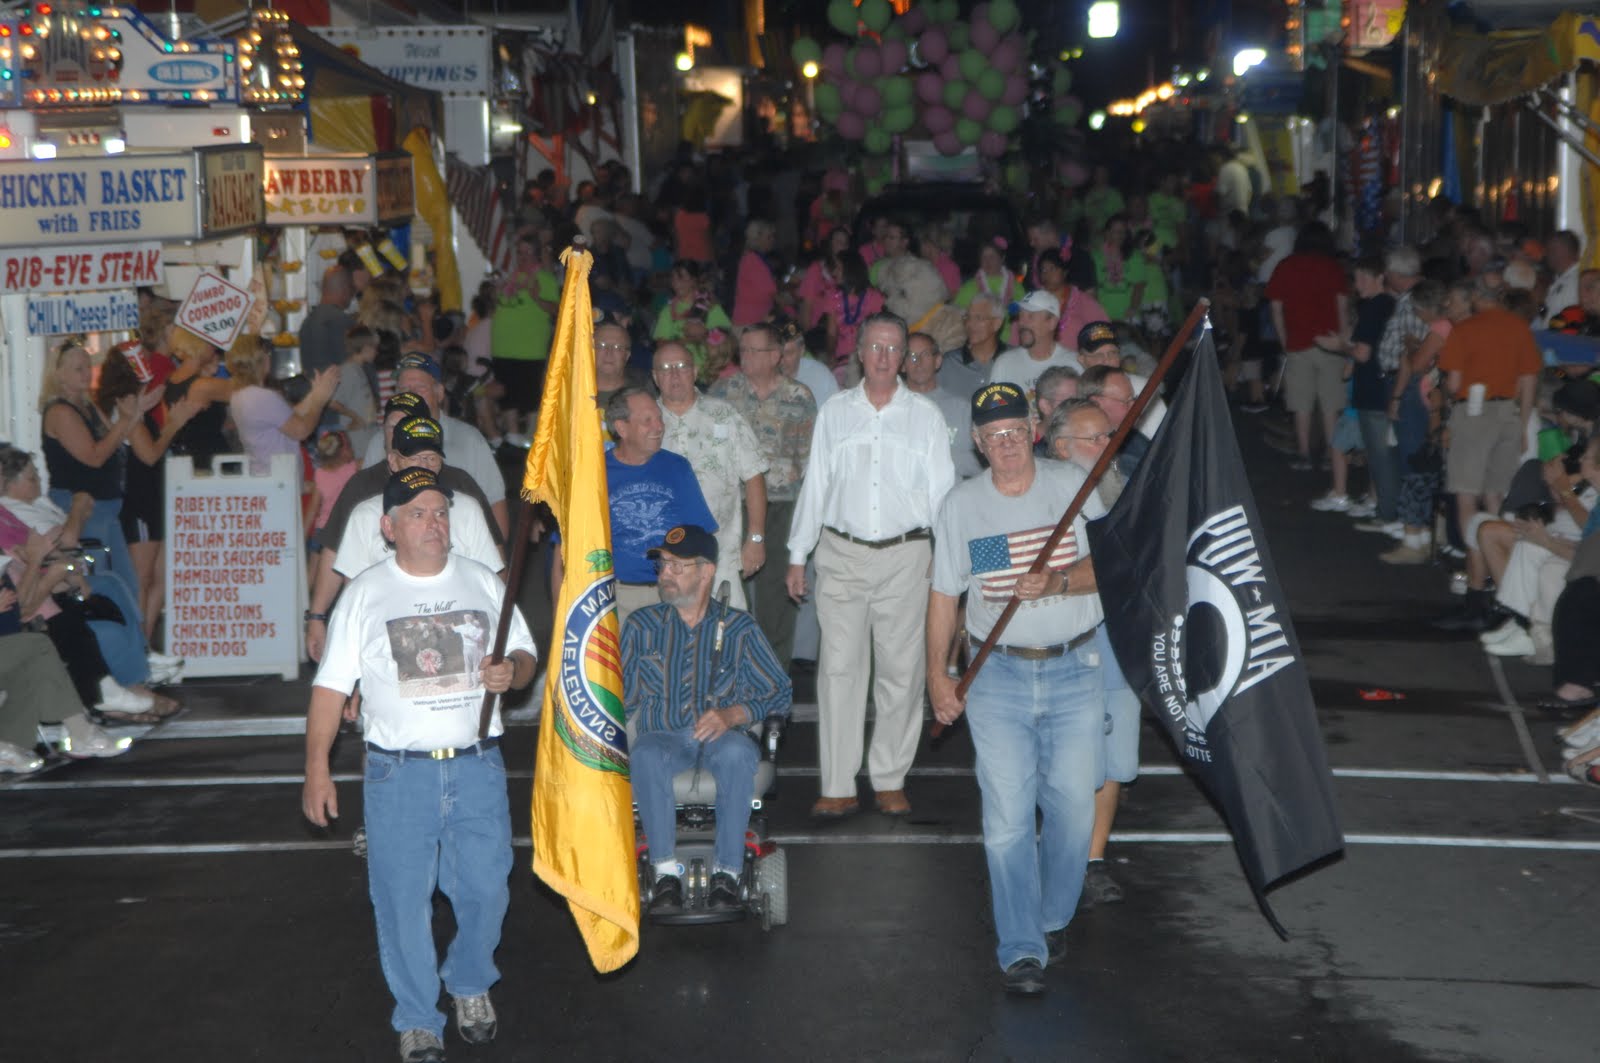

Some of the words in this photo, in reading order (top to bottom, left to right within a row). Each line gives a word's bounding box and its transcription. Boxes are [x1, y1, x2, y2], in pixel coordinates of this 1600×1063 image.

[0, 170, 88, 210] HICKEN
[101, 168, 187, 204] BASKET
[264, 168, 367, 194] AWBERRY
[38, 213, 80, 234] with
[89, 210, 141, 232] FRIES
[5, 253, 93, 291] RIB-EYE
[98, 249, 160, 284] STEAK
[191, 284, 225, 305] JUMBO
[65, 299, 108, 332] Cheese
[110, 295, 139, 330] Fries
[203, 316, 236, 334] $3.00
[175, 496, 221, 512] RIBEYE
[225, 496, 267, 511] STEAK
[175, 515, 218, 530] PHILLY
[220, 514, 262, 530] STEAK
[174, 533, 224, 548] ITALIAN
[228, 532, 287, 548] SAUSAGE
[174, 551, 219, 566] POLISH
[223, 550, 281, 566] SAUSAGE
[173, 569, 264, 585] HAMBURGERS
[173, 587, 200, 603] HOT
[204, 587, 240, 602] DOGS
[1187, 504, 1267, 587] POW
[1232, 603, 1296, 697] MIA
[173, 605, 263, 621] TENDERLOINS
[172, 623, 227, 639] CHICKEN
[230, 622, 276, 638] STRIPS
[172, 641, 208, 657] CORN
[211, 641, 247, 657] DOGS
[1153, 632, 1166, 661] YOU
[1155, 664, 1173, 694] ARE
[1164, 695, 1187, 722] NOT
